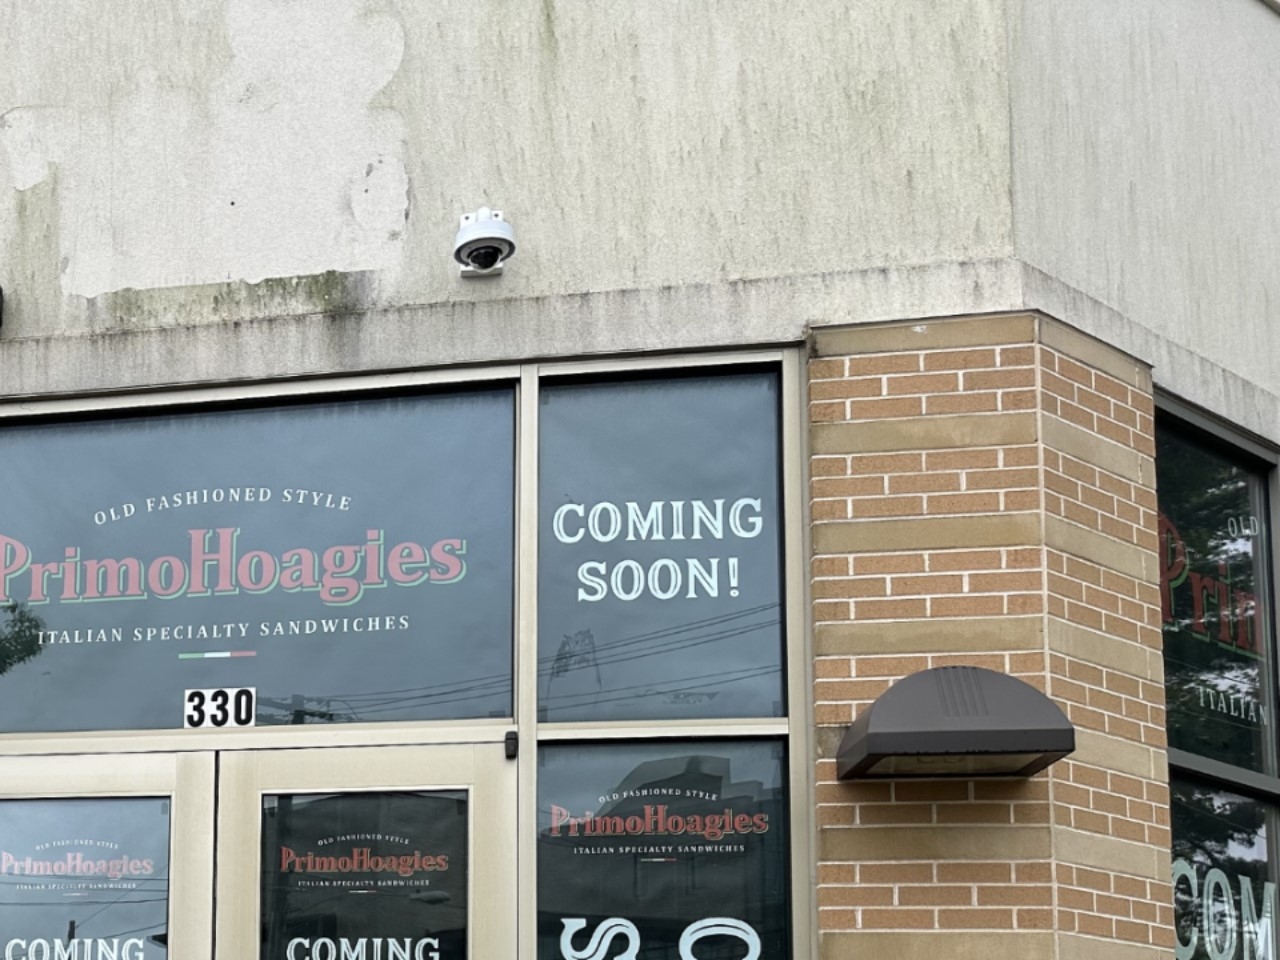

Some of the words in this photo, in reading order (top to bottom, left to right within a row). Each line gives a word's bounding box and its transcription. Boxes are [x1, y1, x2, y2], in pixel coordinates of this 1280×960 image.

[94, 503, 136, 526] OLD
[146, 487, 272, 513] FASHIONED
[282, 488, 353, 512] STYLE
[552, 497, 764, 544] COMING
[1227, 516, 1259, 538] OLD
[577, 557, 740, 602] SOON!
[37, 627, 123, 646] ITALIAN
[132, 622, 250, 642] SPECIALTY
[259, 615, 411, 637] SANDWICHES
[186, 689, 253, 728] 330
[1198, 686, 1268, 726] ITALIAN
[599, 792, 620, 804] OLD
[623, 788, 681, 799] FASHIONED
[685, 789, 718, 801] STYLE
[550, 803, 769, 841] PrimoHoagies
[317, 837, 334, 846] OLD
[574, 847, 614, 855] ITALIAN
[619, 845, 673, 853] SPECIALTY
[677, 844, 745, 853] SANDWICHES
[0, 851, 154, 880] PrimoHoagies
[280, 846, 449, 877] PrimoHoagies
